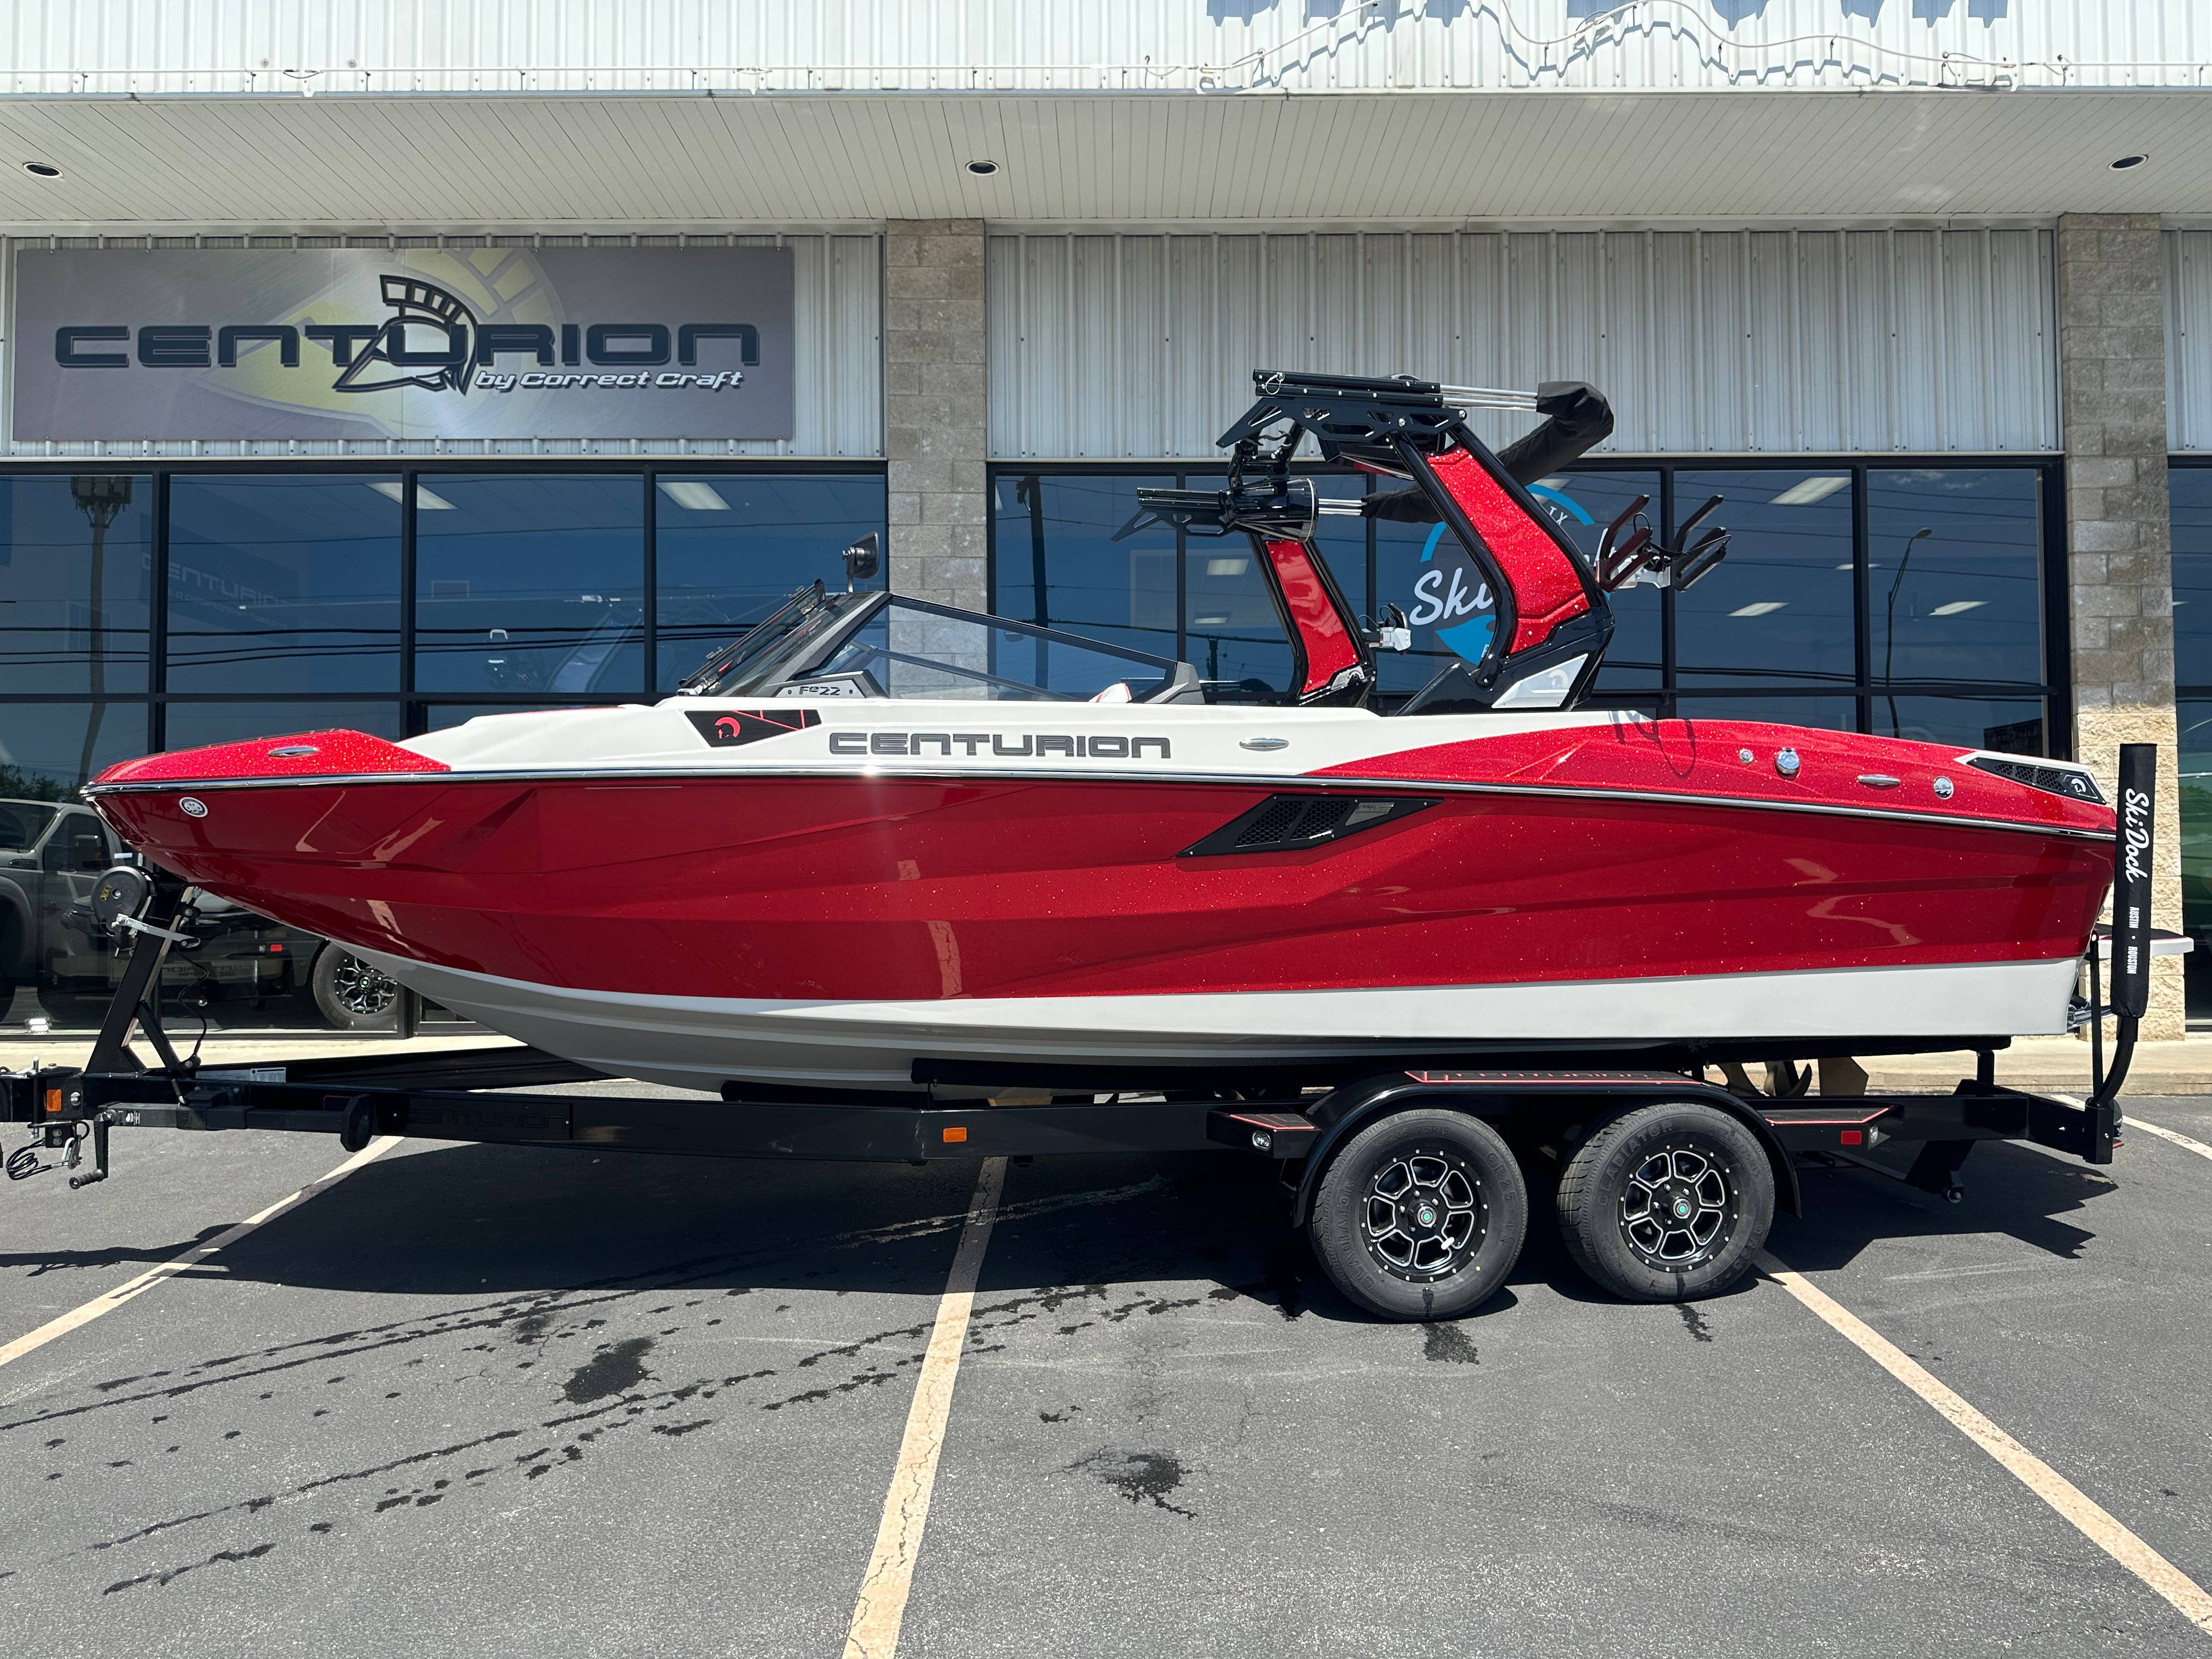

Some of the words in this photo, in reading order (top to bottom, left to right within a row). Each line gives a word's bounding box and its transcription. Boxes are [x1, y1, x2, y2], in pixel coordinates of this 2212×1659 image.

[55, 324, 759, 367] CENTURION
[475, 371, 515, 390] by
[520, 371, 652, 387] Correct
[654, 371, 744, 391] Craft
[830, 733, 1171, 758] CENTURION
[2125, 788, 2148, 827] Ski
[2125, 827, 2148, 883] Dock
[2129, 907, 2140, 928] AUSTIN
[2126, 946, 2138, 974] HOUSTON
[1598, 1121, 1674, 1205] GLADIATOR
[1338, 1178, 1375, 1290] GLADIATOR
